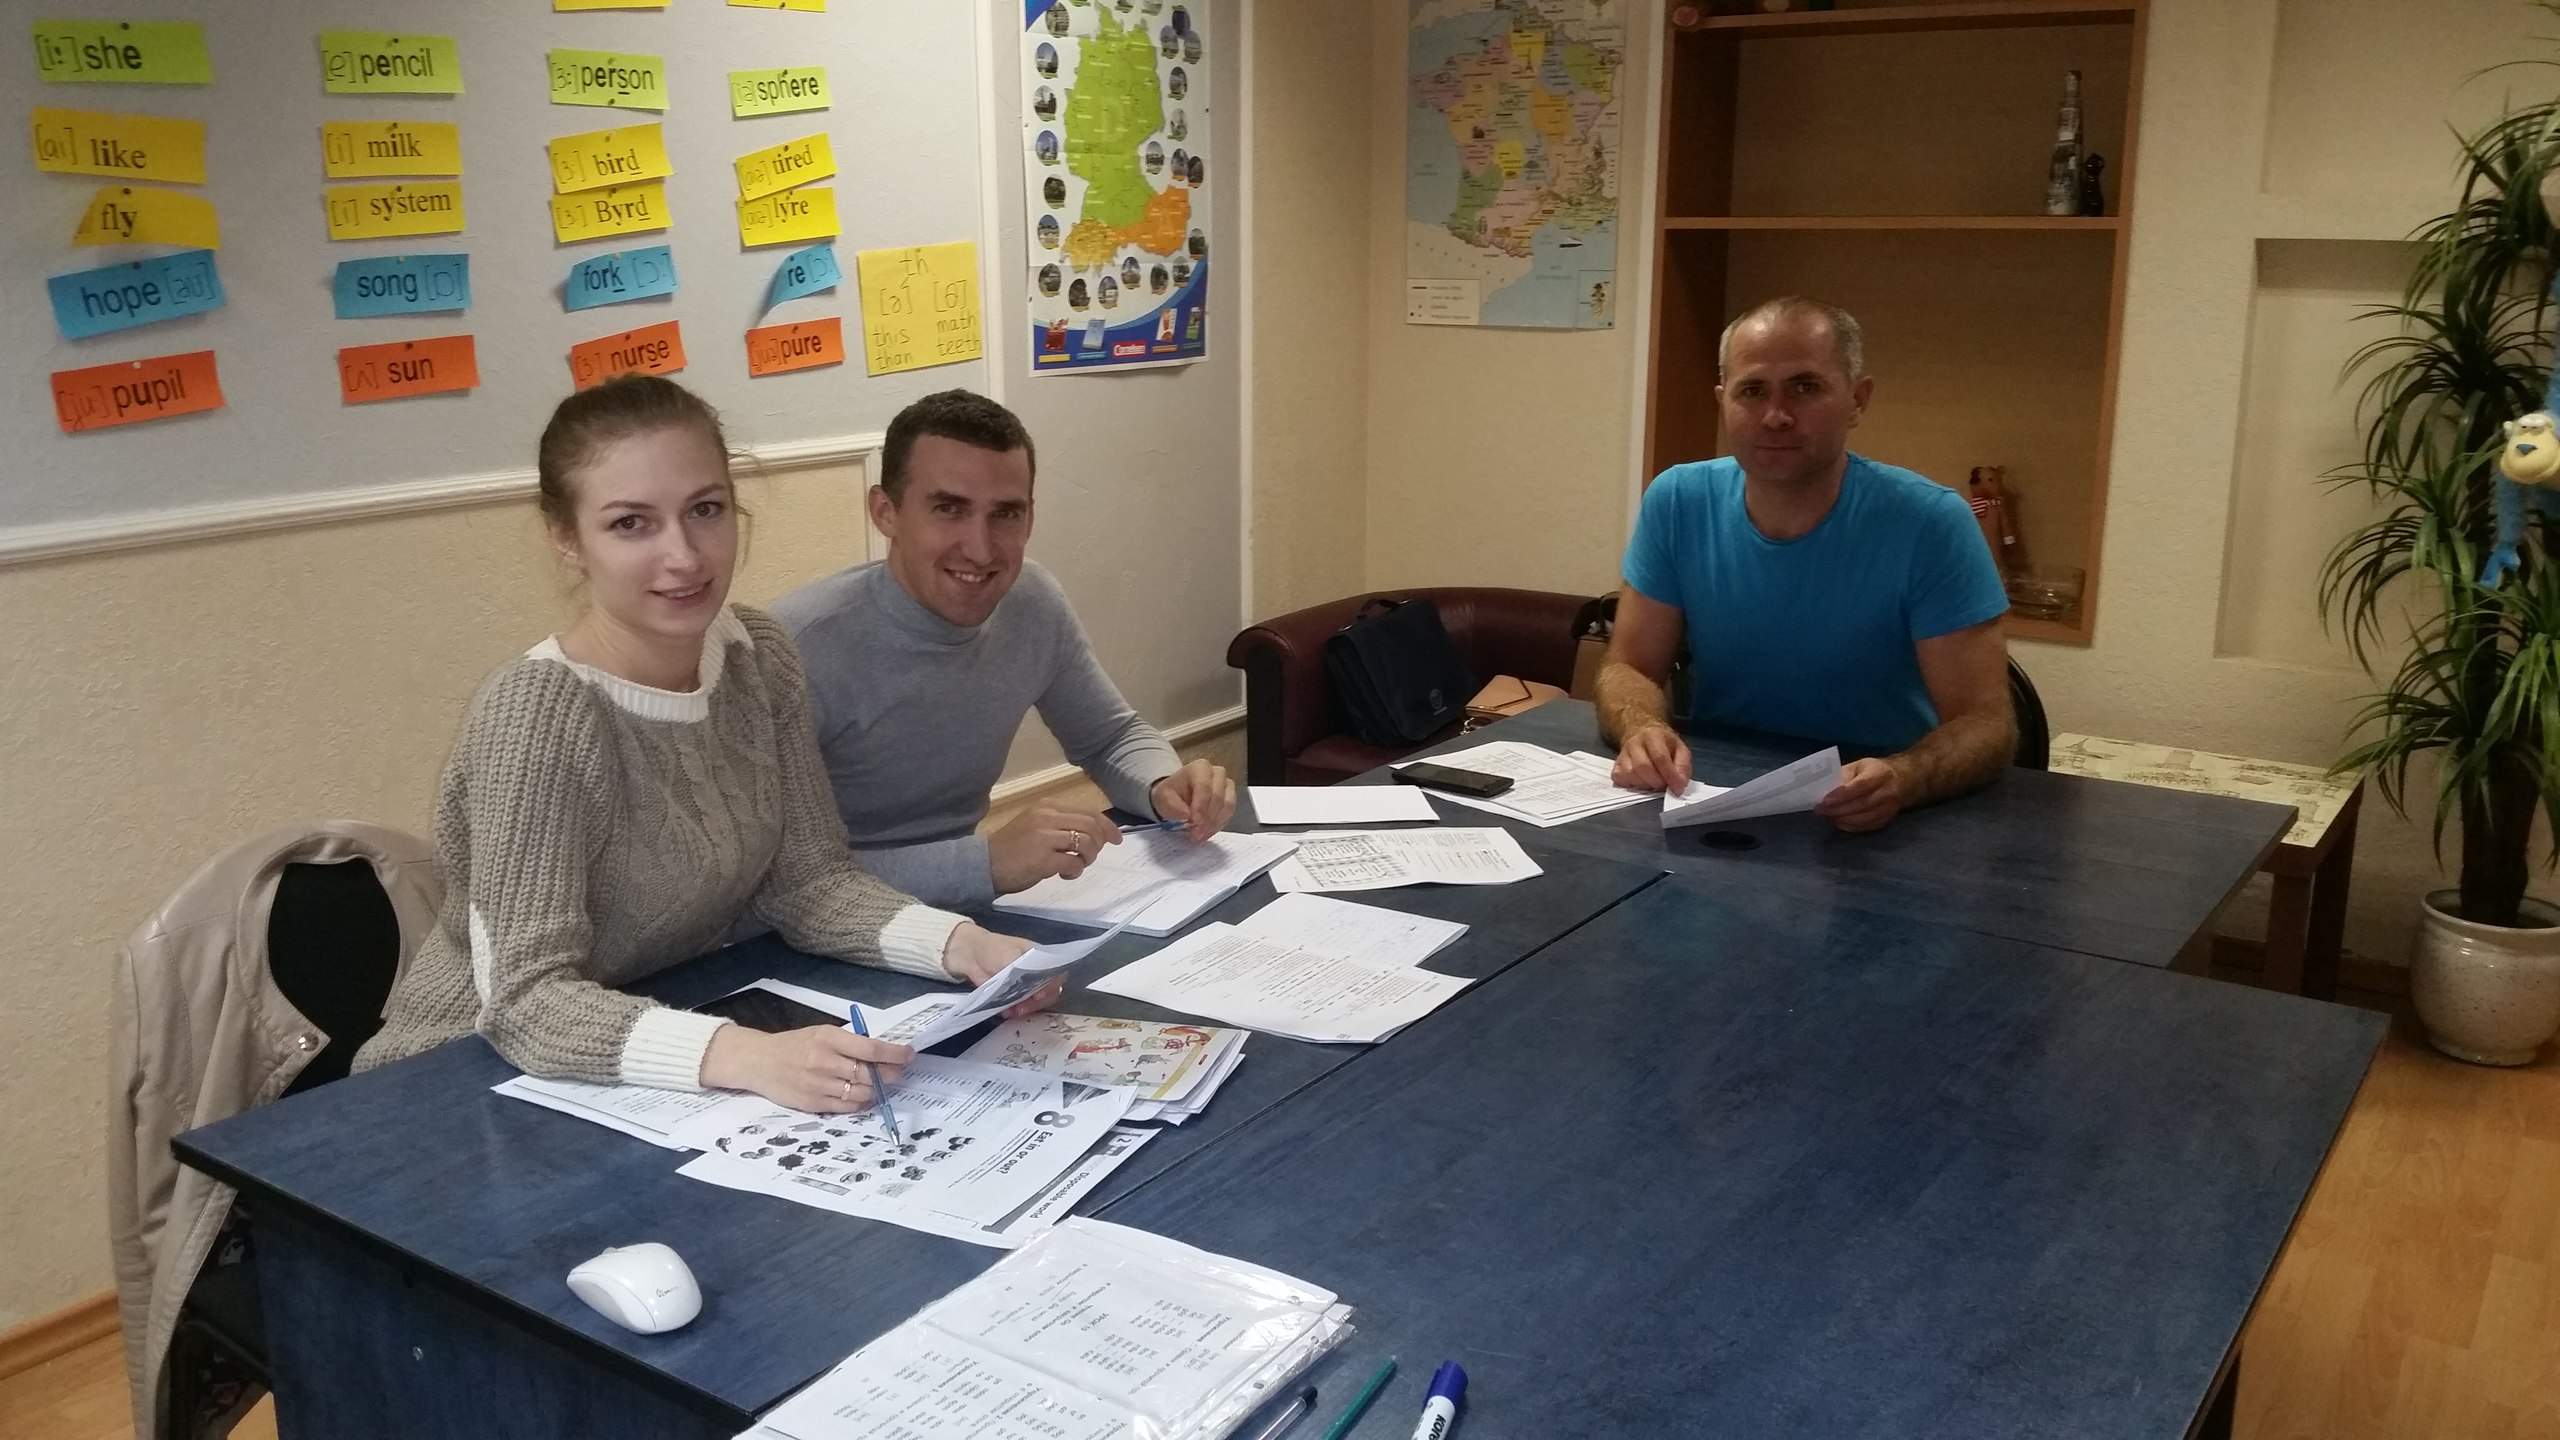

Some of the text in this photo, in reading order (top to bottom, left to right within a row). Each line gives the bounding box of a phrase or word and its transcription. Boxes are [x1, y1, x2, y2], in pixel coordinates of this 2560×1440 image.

[83, 36, 142, 69] she
[360, 48, 434, 83] pencil
[582, 66, 654, 94] person
[758, 73, 819, 106] sphere
[90, 138, 147, 168] like
[368, 133, 422, 158] milk
[772, 144, 814, 174] tired
[592, 148, 642, 176] bird
[101, 203, 138, 238] fly
[370, 193, 452, 221] system
[594, 194, 651, 226] Byrd
[774, 198, 808, 223] lyre
[358, 273, 418, 302] song
[584, 261, 626, 292] fork
[80, 282, 161, 318] hope
[872, 311, 976, 347] this math
[611, 340, 670, 371] nurse
[780, 335, 822, 364] pure
[876, 334, 982, 369] than teeth
[388, 358, 434, 384] sun
[112, 369, 186, 418] pupil
[1034, 1110, 1075, 1128] 8
[1036, 1130, 1053, 1144] Eat
[1017, 1150, 1028, 1160] or
[1030, 1172, 1090, 1219] Disposable world
